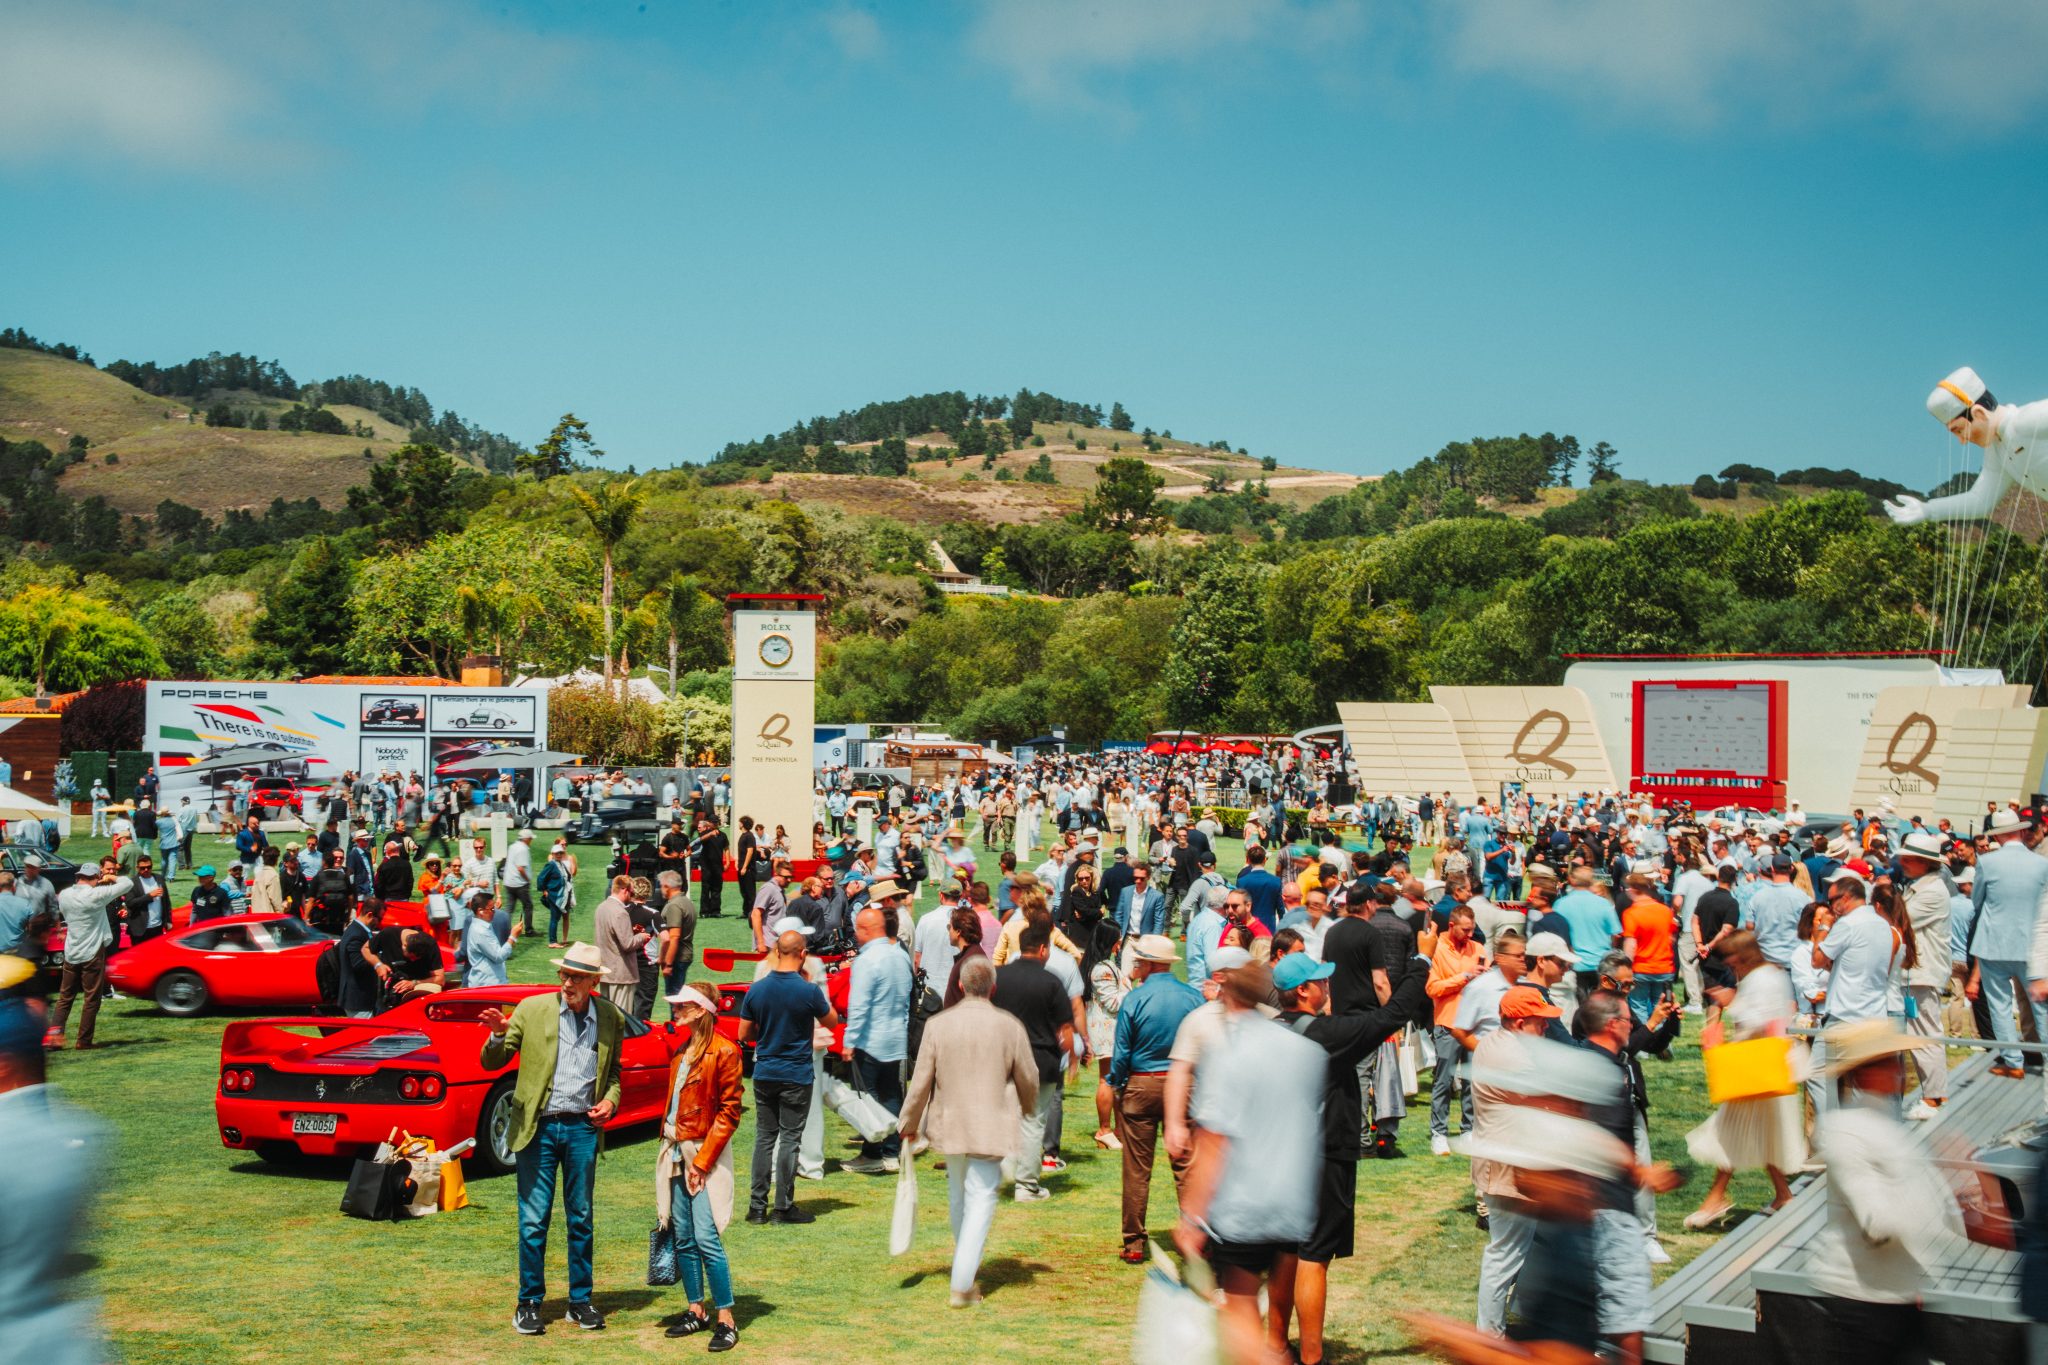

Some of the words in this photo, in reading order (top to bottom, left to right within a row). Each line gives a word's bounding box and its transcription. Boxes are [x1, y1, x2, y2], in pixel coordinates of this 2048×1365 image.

[161, 689, 268, 699] PORSCHE
[194, 711, 252, 736] There
[251, 725, 265, 738] is
[266, 731, 280, 741] no
[375, 747, 409, 755] Nobody's
[762, 740, 781, 749] Quail
[1516, 766, 1552, 783] Quail
[1889, 776, 1921, 796] Quail
